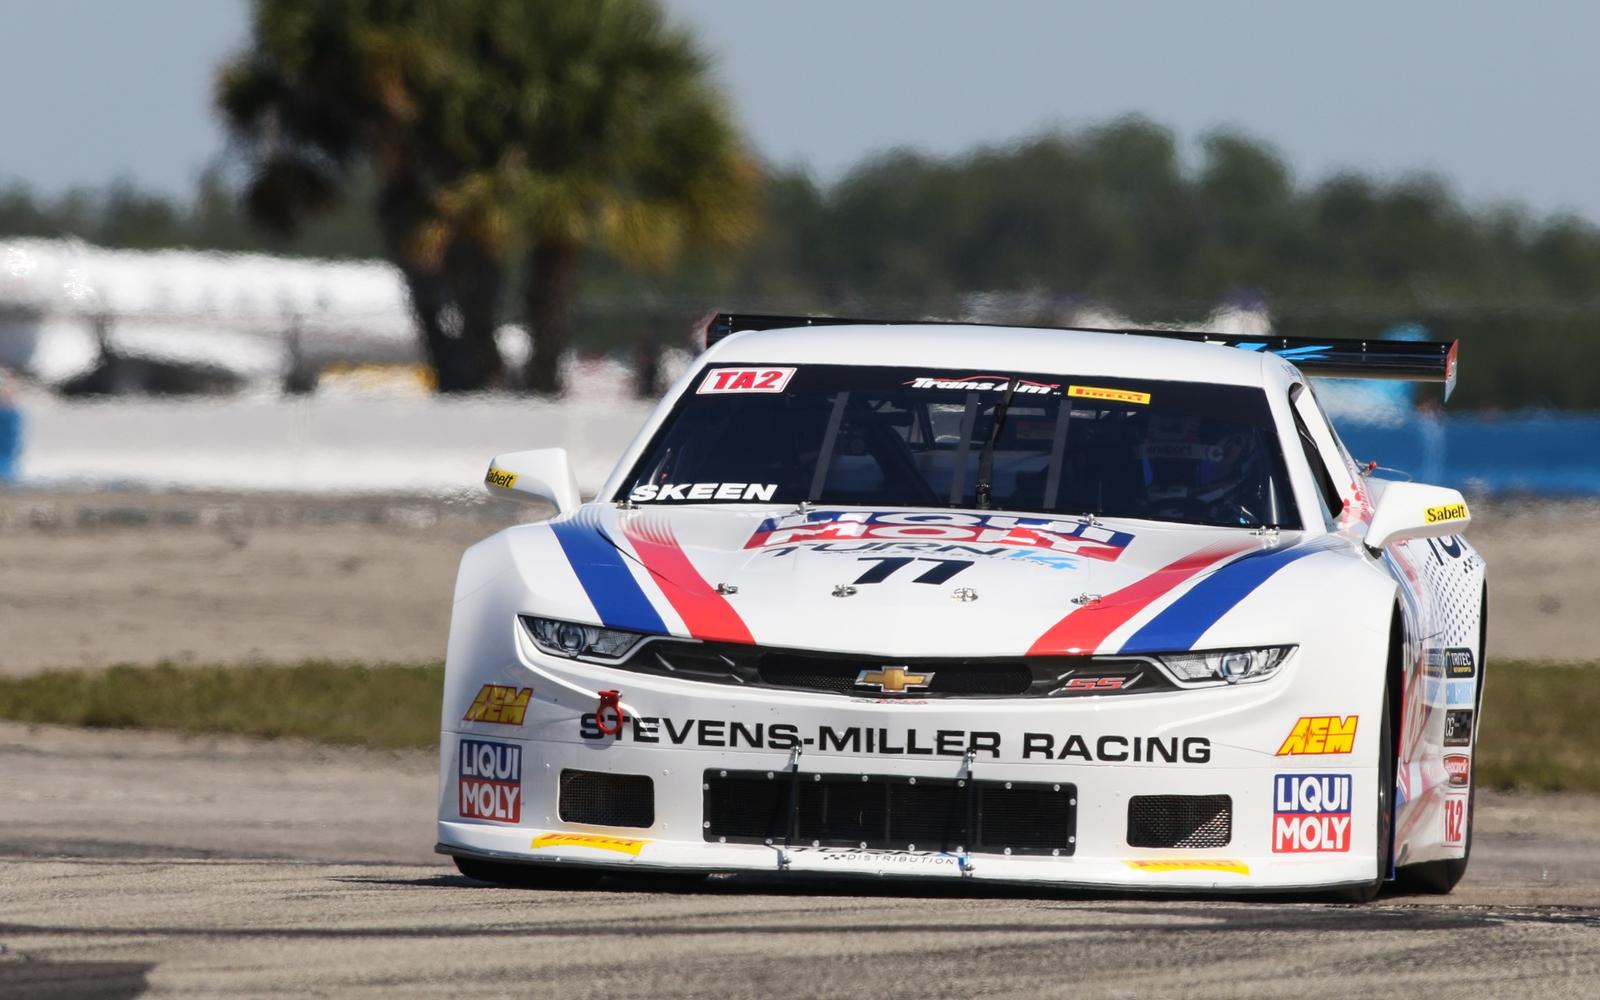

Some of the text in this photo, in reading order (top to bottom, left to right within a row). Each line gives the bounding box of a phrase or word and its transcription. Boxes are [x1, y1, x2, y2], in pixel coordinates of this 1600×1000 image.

[713, 371, 783, 389] TA2
[911, 377, 992, 390] Trans
[628, 482, 778, 501] SKEEN
[1427, 505, 1466, 522] Sabelt
[764, 522, 1123, 553] MOLY
[1061, 677, 1126, 691] SS
[463, 684, 534, 726] AEM
[579, 712, 1211, 764] STEVENS-MILLER RACING
[1274, 715, 1359, 757] AEM
[462, 742, 520, 780] LIQUI
[462, 781, 520, 819] MOLY
[1276, 776, 1349, 813] LIQUI
[1275, 815, 1351, 850] MOLY
[847, 854, 955, 865] DISTRIBUTION
